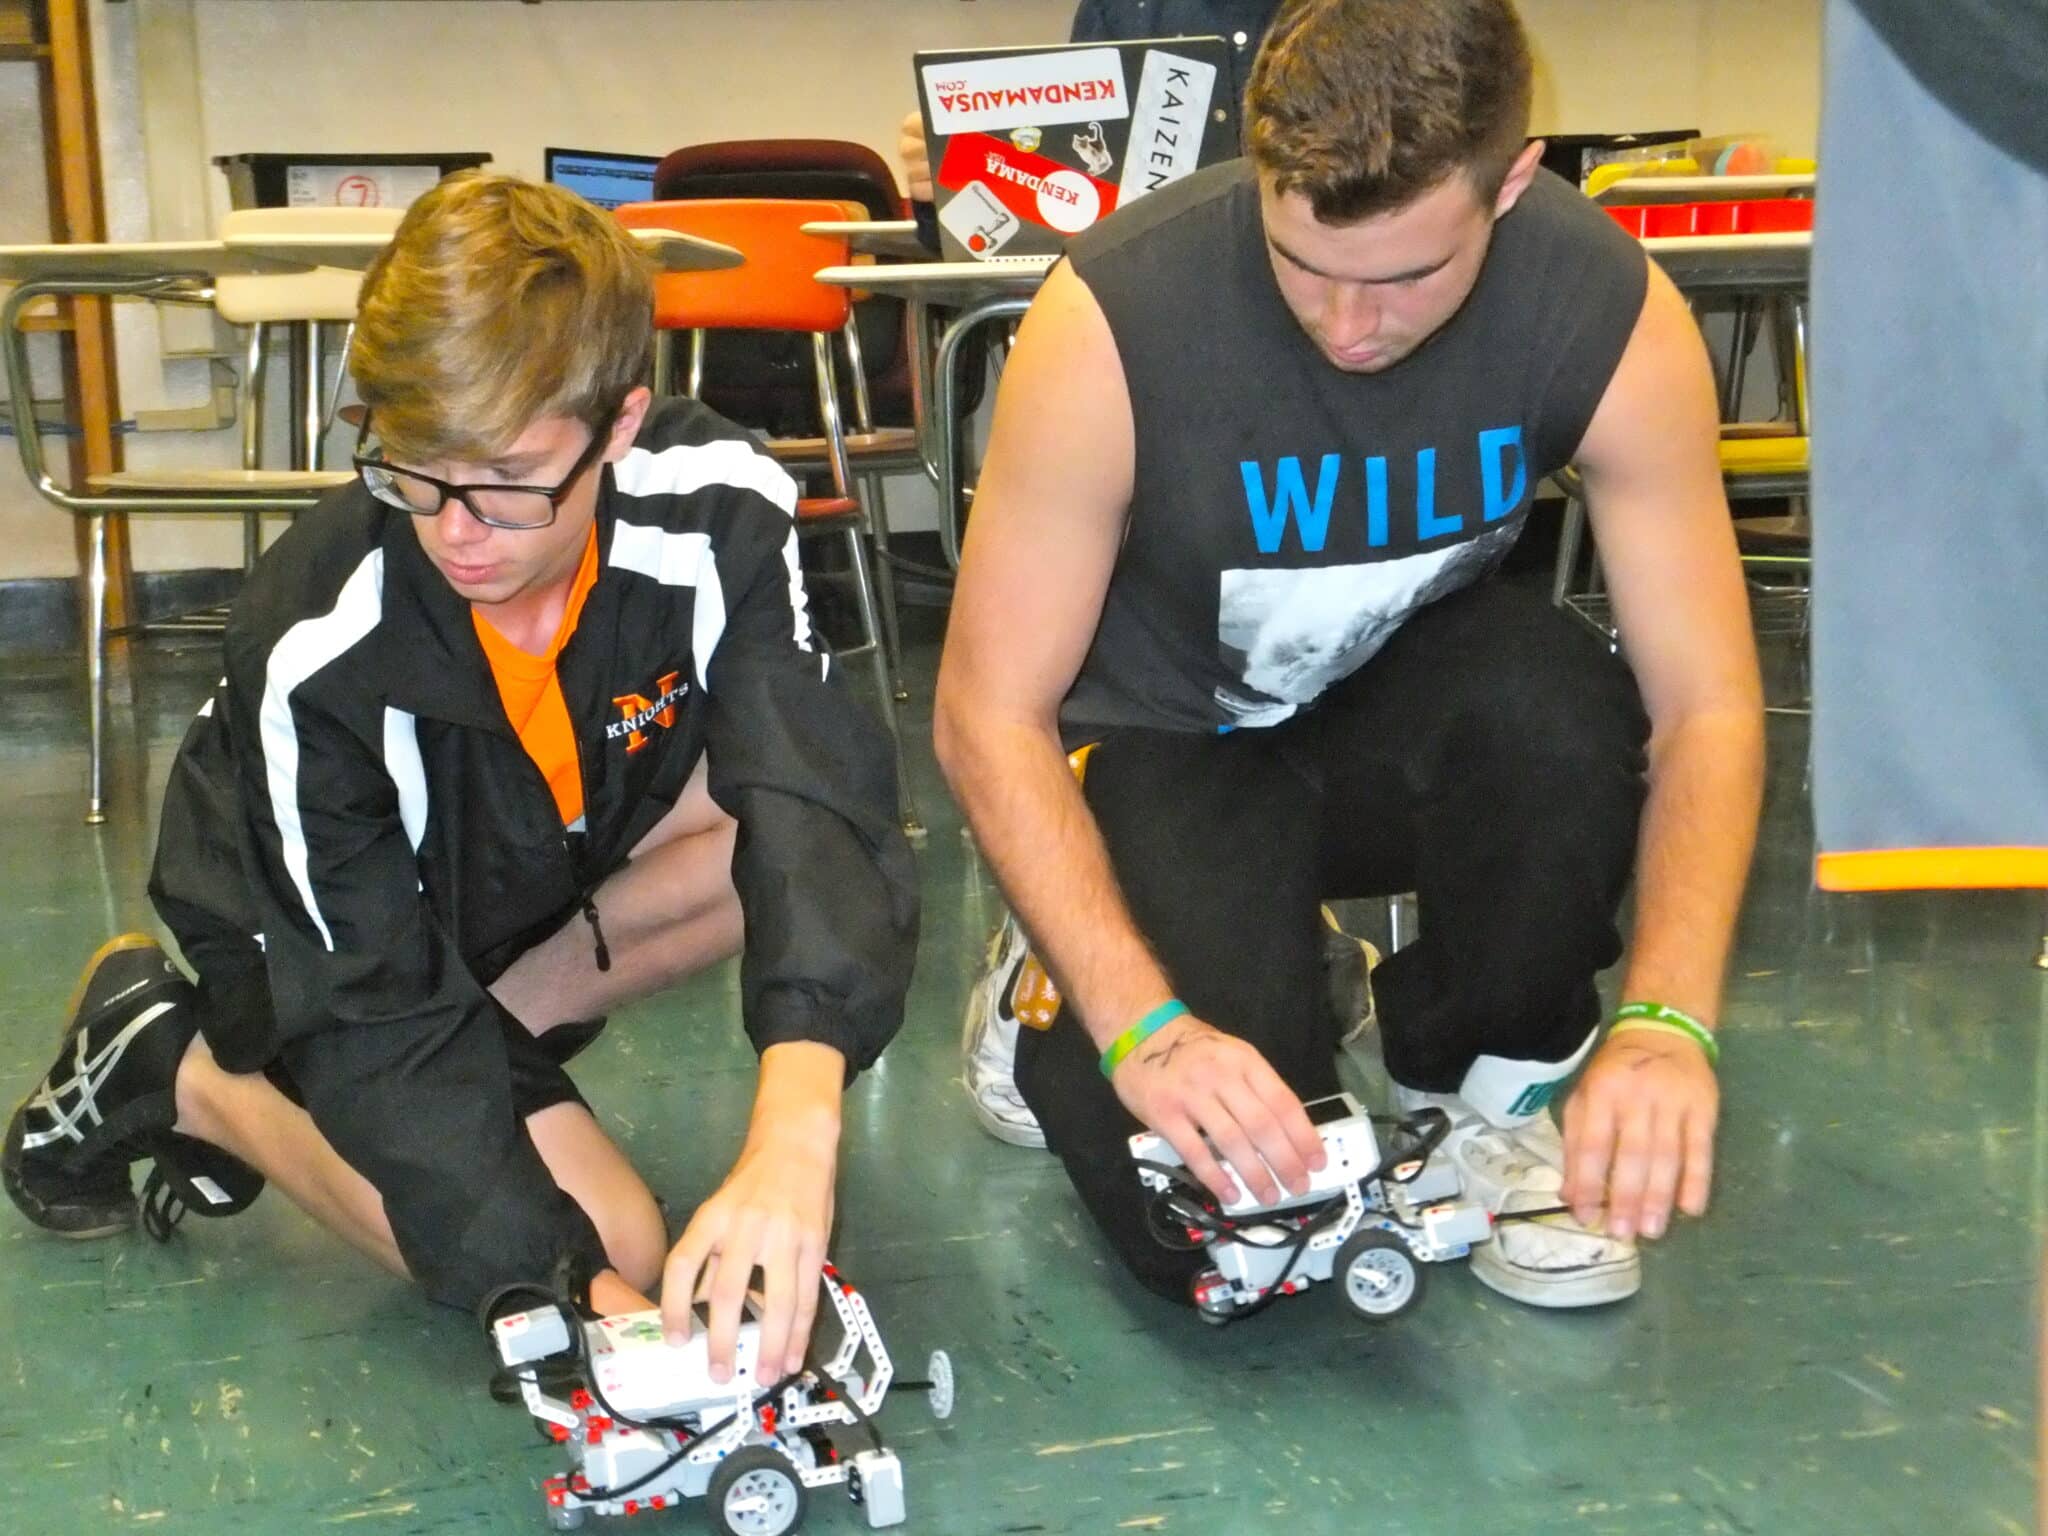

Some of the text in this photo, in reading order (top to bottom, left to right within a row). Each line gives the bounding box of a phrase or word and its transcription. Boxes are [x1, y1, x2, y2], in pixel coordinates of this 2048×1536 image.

[938, 79, 1116, 113] KENDAMAUSA
[1145, 67, 1191, 191] KAIZEN
[351, 183, 368, 207] 7
[984, 157, 1080, 206] KENDAMA
[1240, 425, 1528, 553] WILD
[605, 682, 689, 739] KNIGHTS
